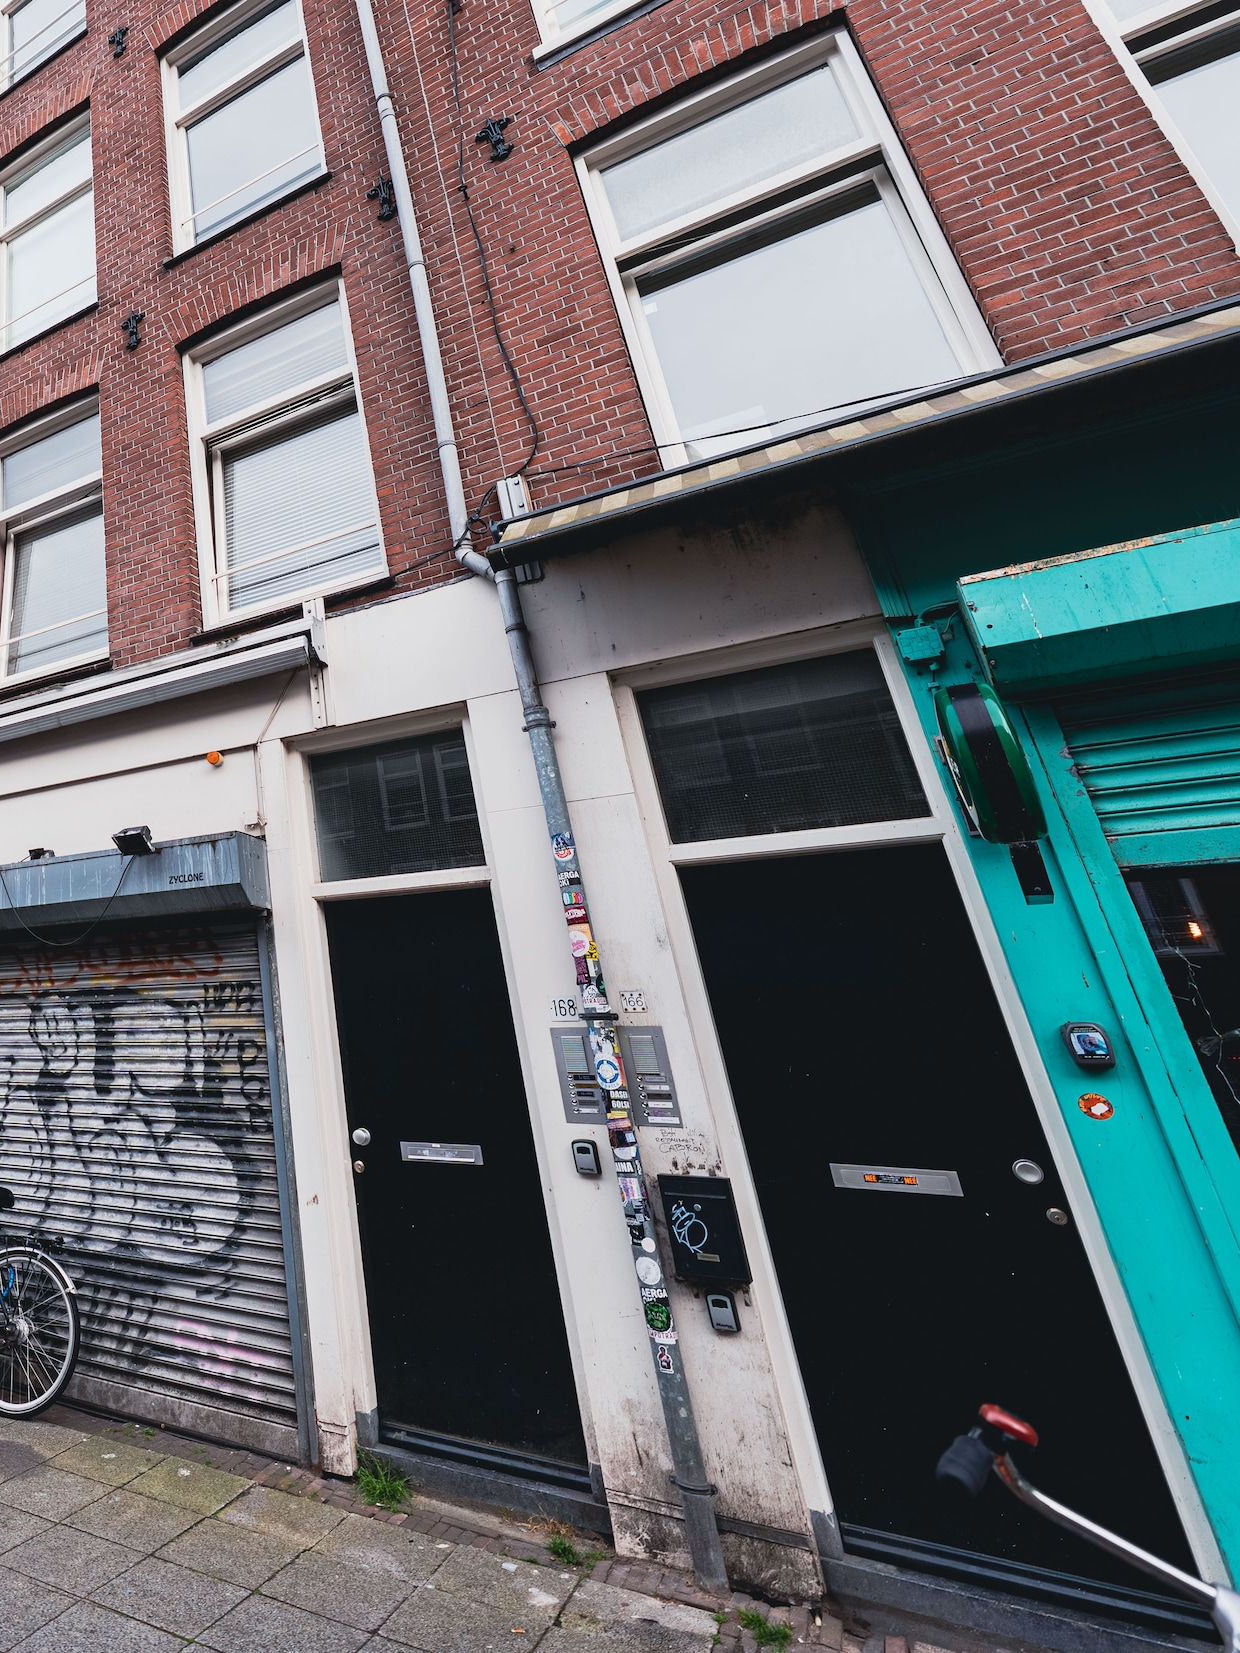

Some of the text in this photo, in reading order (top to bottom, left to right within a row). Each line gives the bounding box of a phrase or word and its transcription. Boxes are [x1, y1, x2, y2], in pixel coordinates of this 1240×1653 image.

[169, 872, 204, 884] ZYCLONE
[623, 997, 643, 1007] 166
[552, 999, 576, 1017] 168
[864, 1174, 878, 1183] NEE
[904, 1176, 917, 1185] NEE
